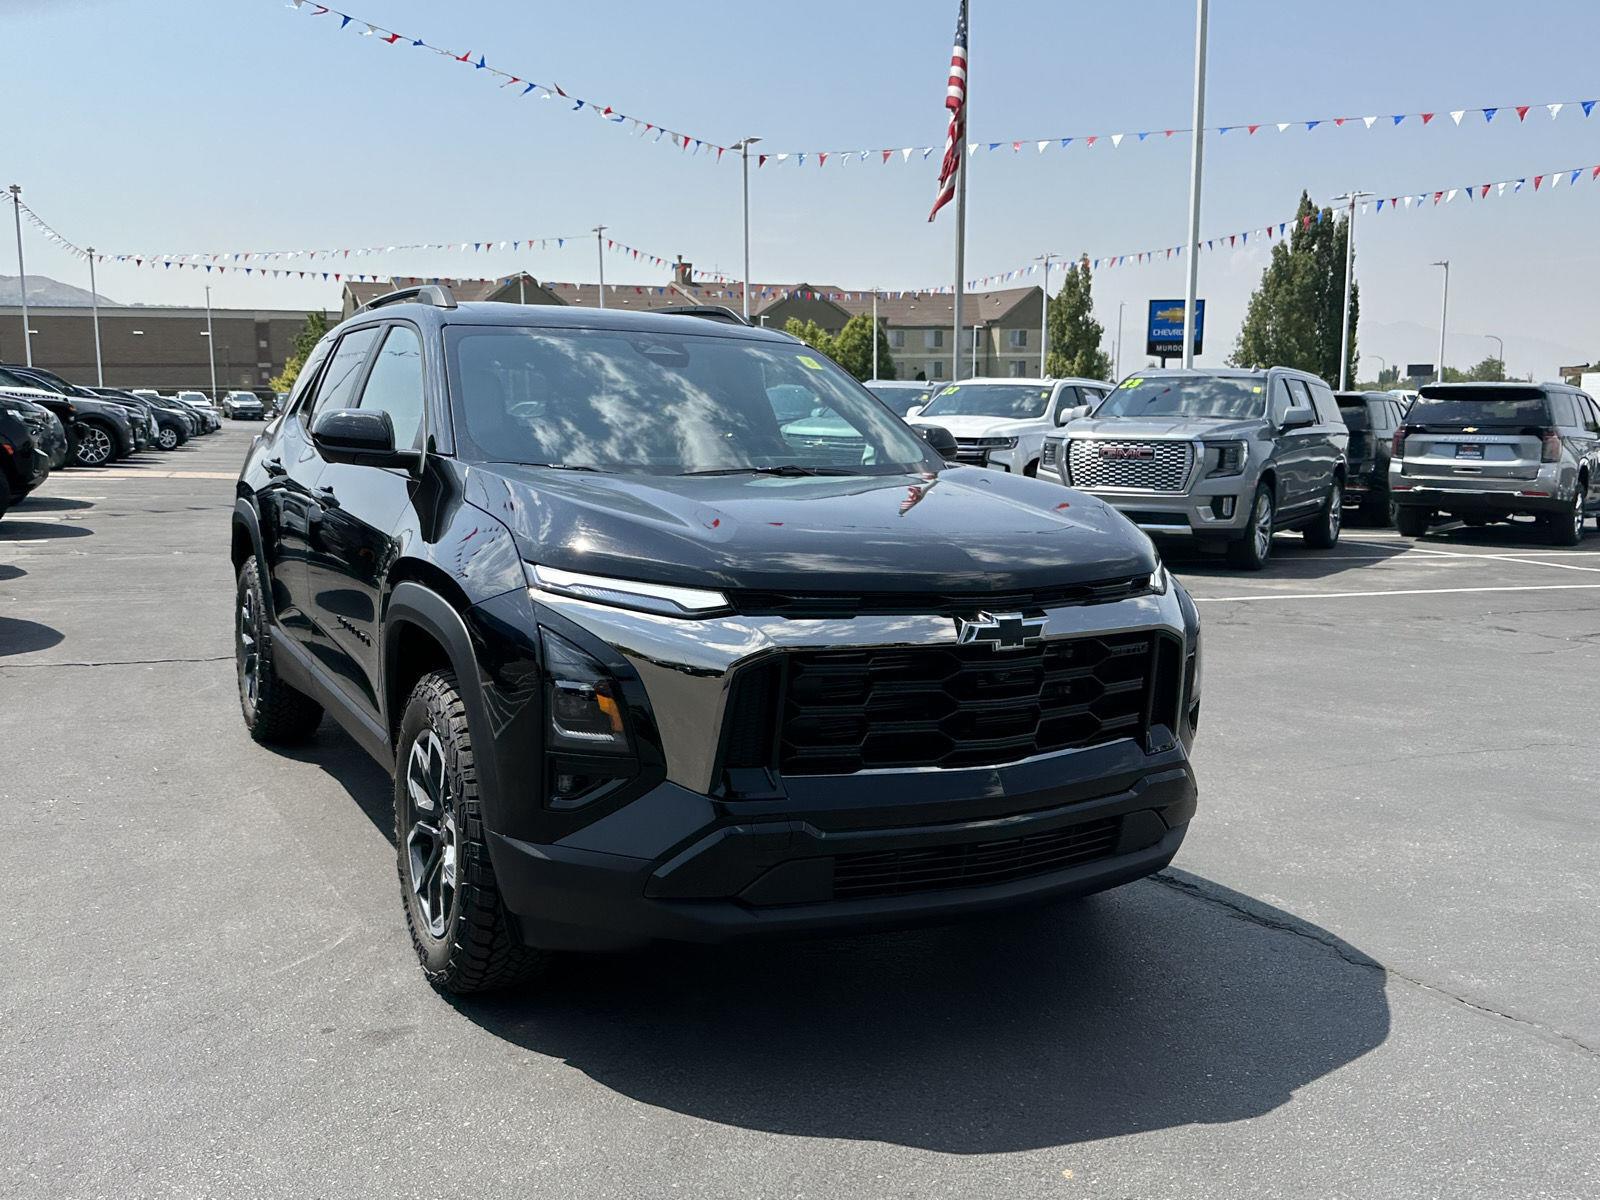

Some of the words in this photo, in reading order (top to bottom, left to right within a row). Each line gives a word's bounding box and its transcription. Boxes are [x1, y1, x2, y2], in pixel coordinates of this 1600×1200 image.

[1152, 328, 1198, 336] CHEVROT
[1156, 344, 1184, 352] MURDO
[5, 391, 59, 400] RUBICON
[1099, 448, 1154, 460] GMC
